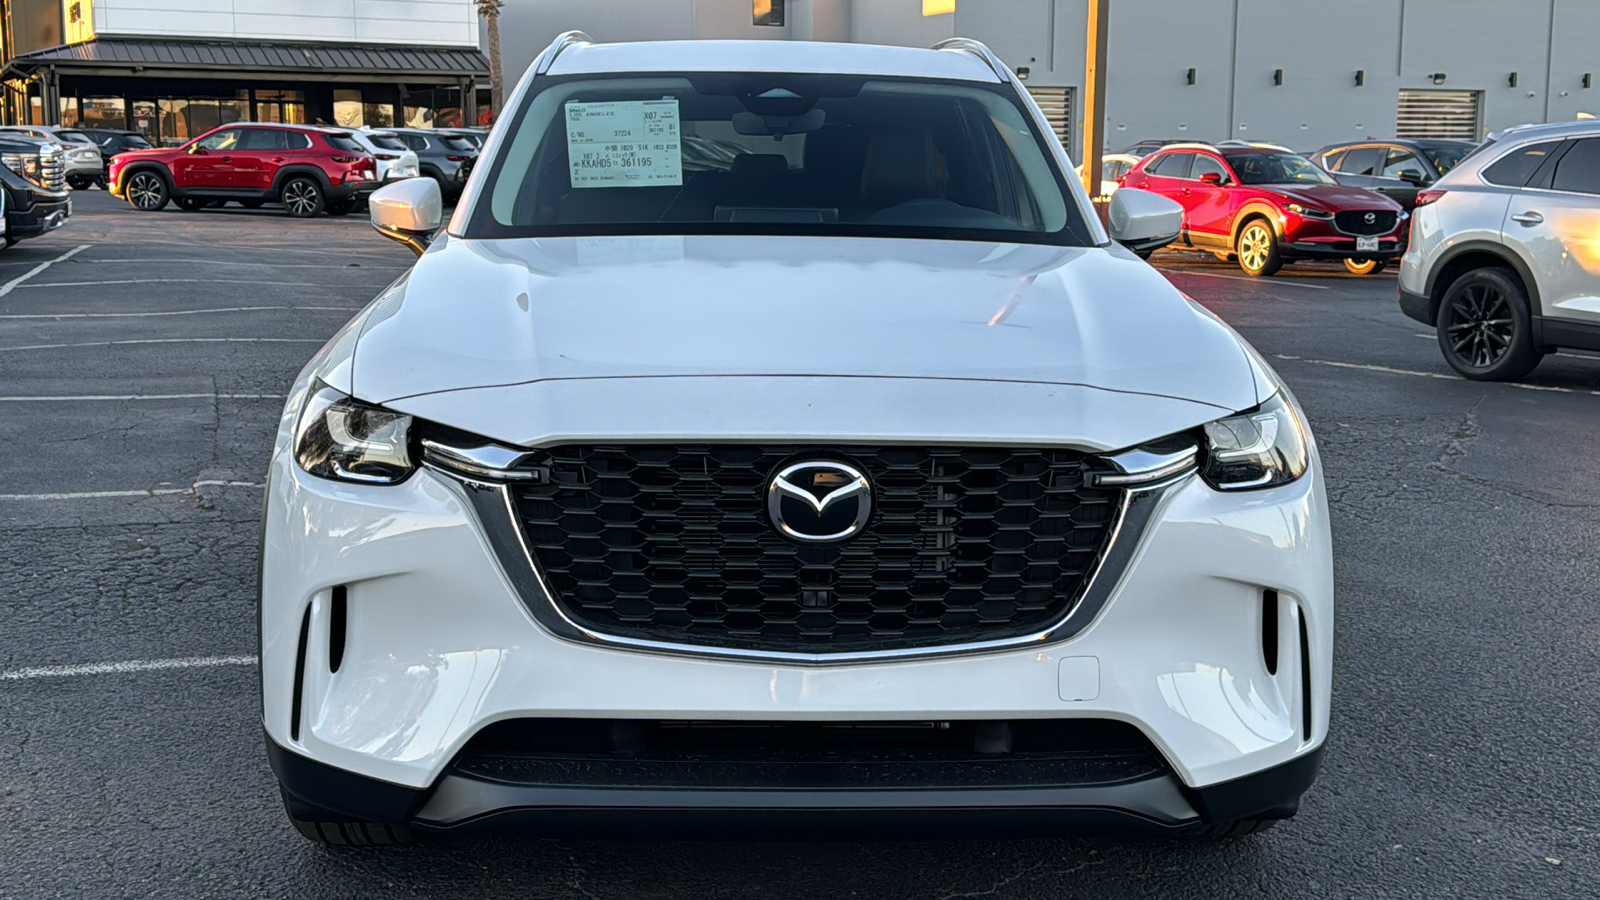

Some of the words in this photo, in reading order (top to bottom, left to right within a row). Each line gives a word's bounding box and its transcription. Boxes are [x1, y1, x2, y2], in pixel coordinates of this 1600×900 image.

[644, 112, 657, 120] X07
[582, 158, 612, 168] KKAHD5
[621, 157, 652, 167] 361195
